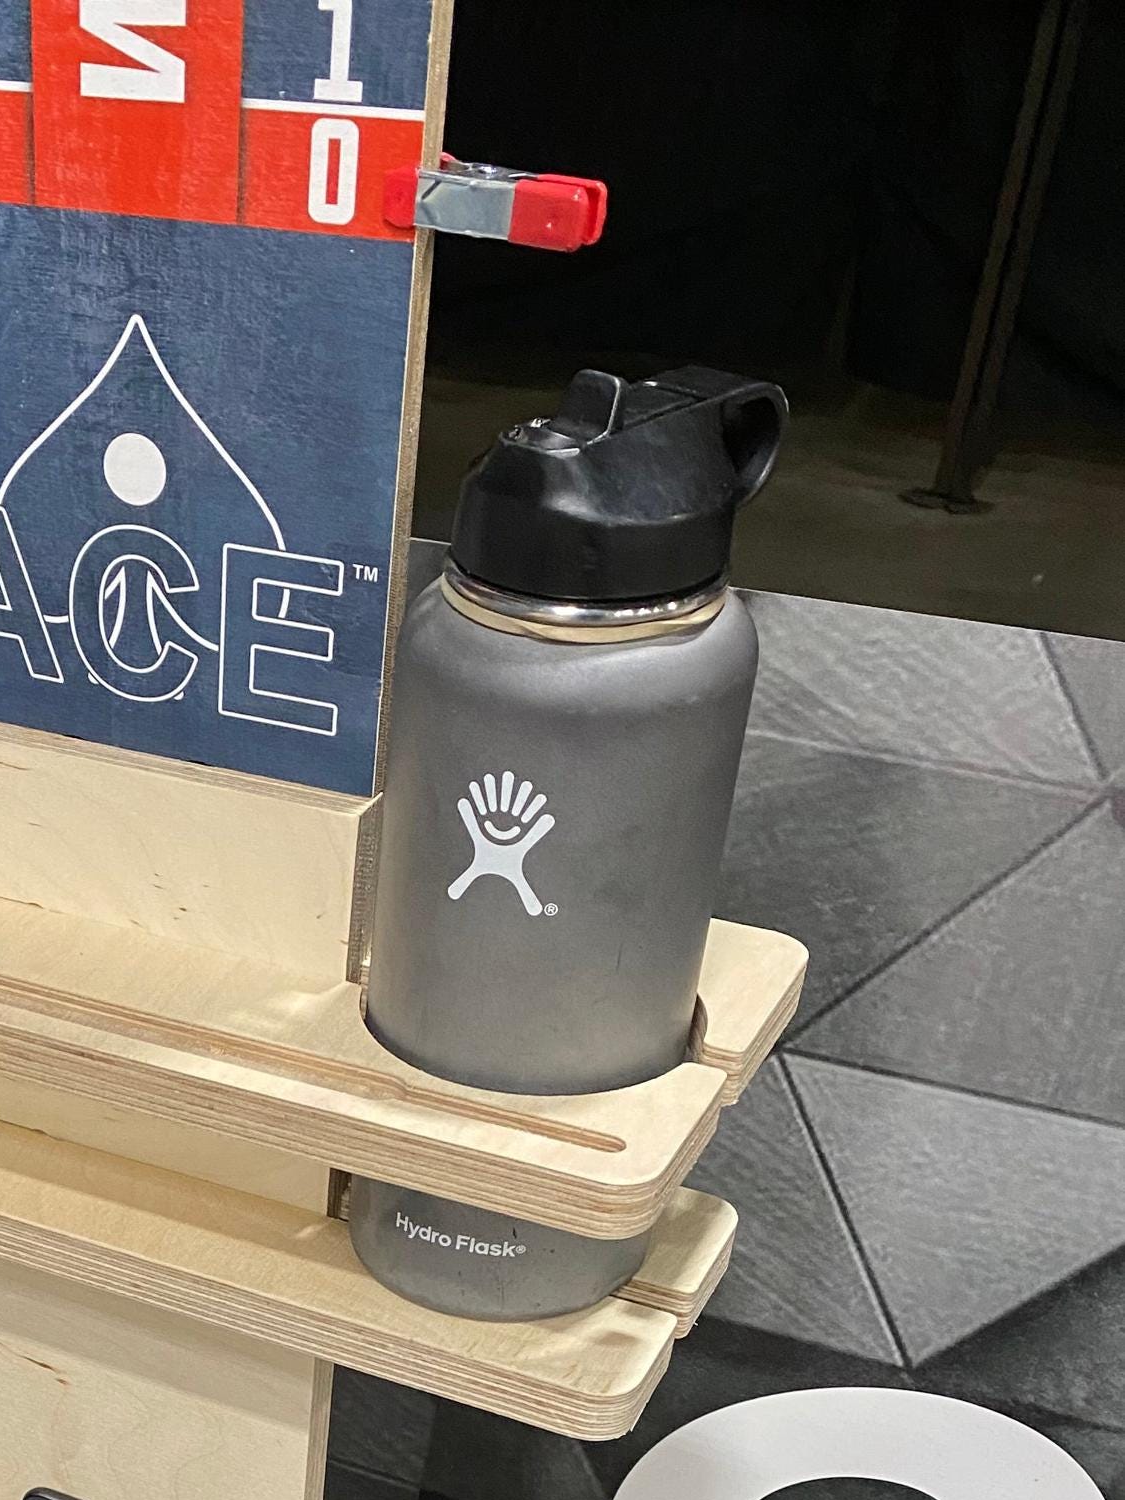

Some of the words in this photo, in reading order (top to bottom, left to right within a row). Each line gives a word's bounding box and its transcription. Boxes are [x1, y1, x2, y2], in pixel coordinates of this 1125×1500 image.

[313, 0, 363, 103] 1
[307, 117, 360, 226] 0
[395, 1211, 452, 1247] Hydro
